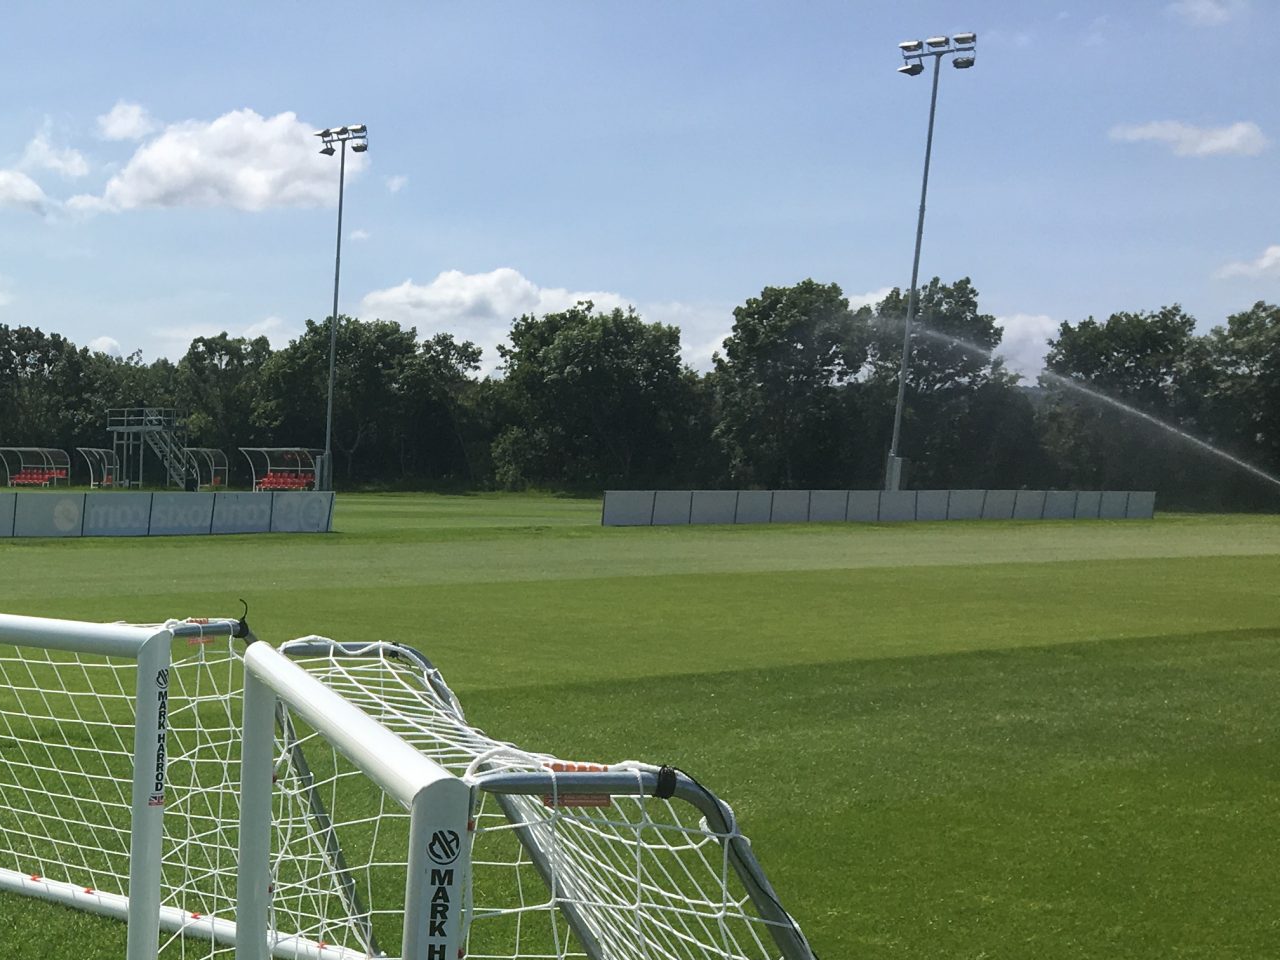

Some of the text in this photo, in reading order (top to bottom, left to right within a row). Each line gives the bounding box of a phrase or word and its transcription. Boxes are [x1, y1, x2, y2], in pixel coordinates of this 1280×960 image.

[154, 690, 168, 792] MARK HARROD
[429, 868, 454, 938] MARK
